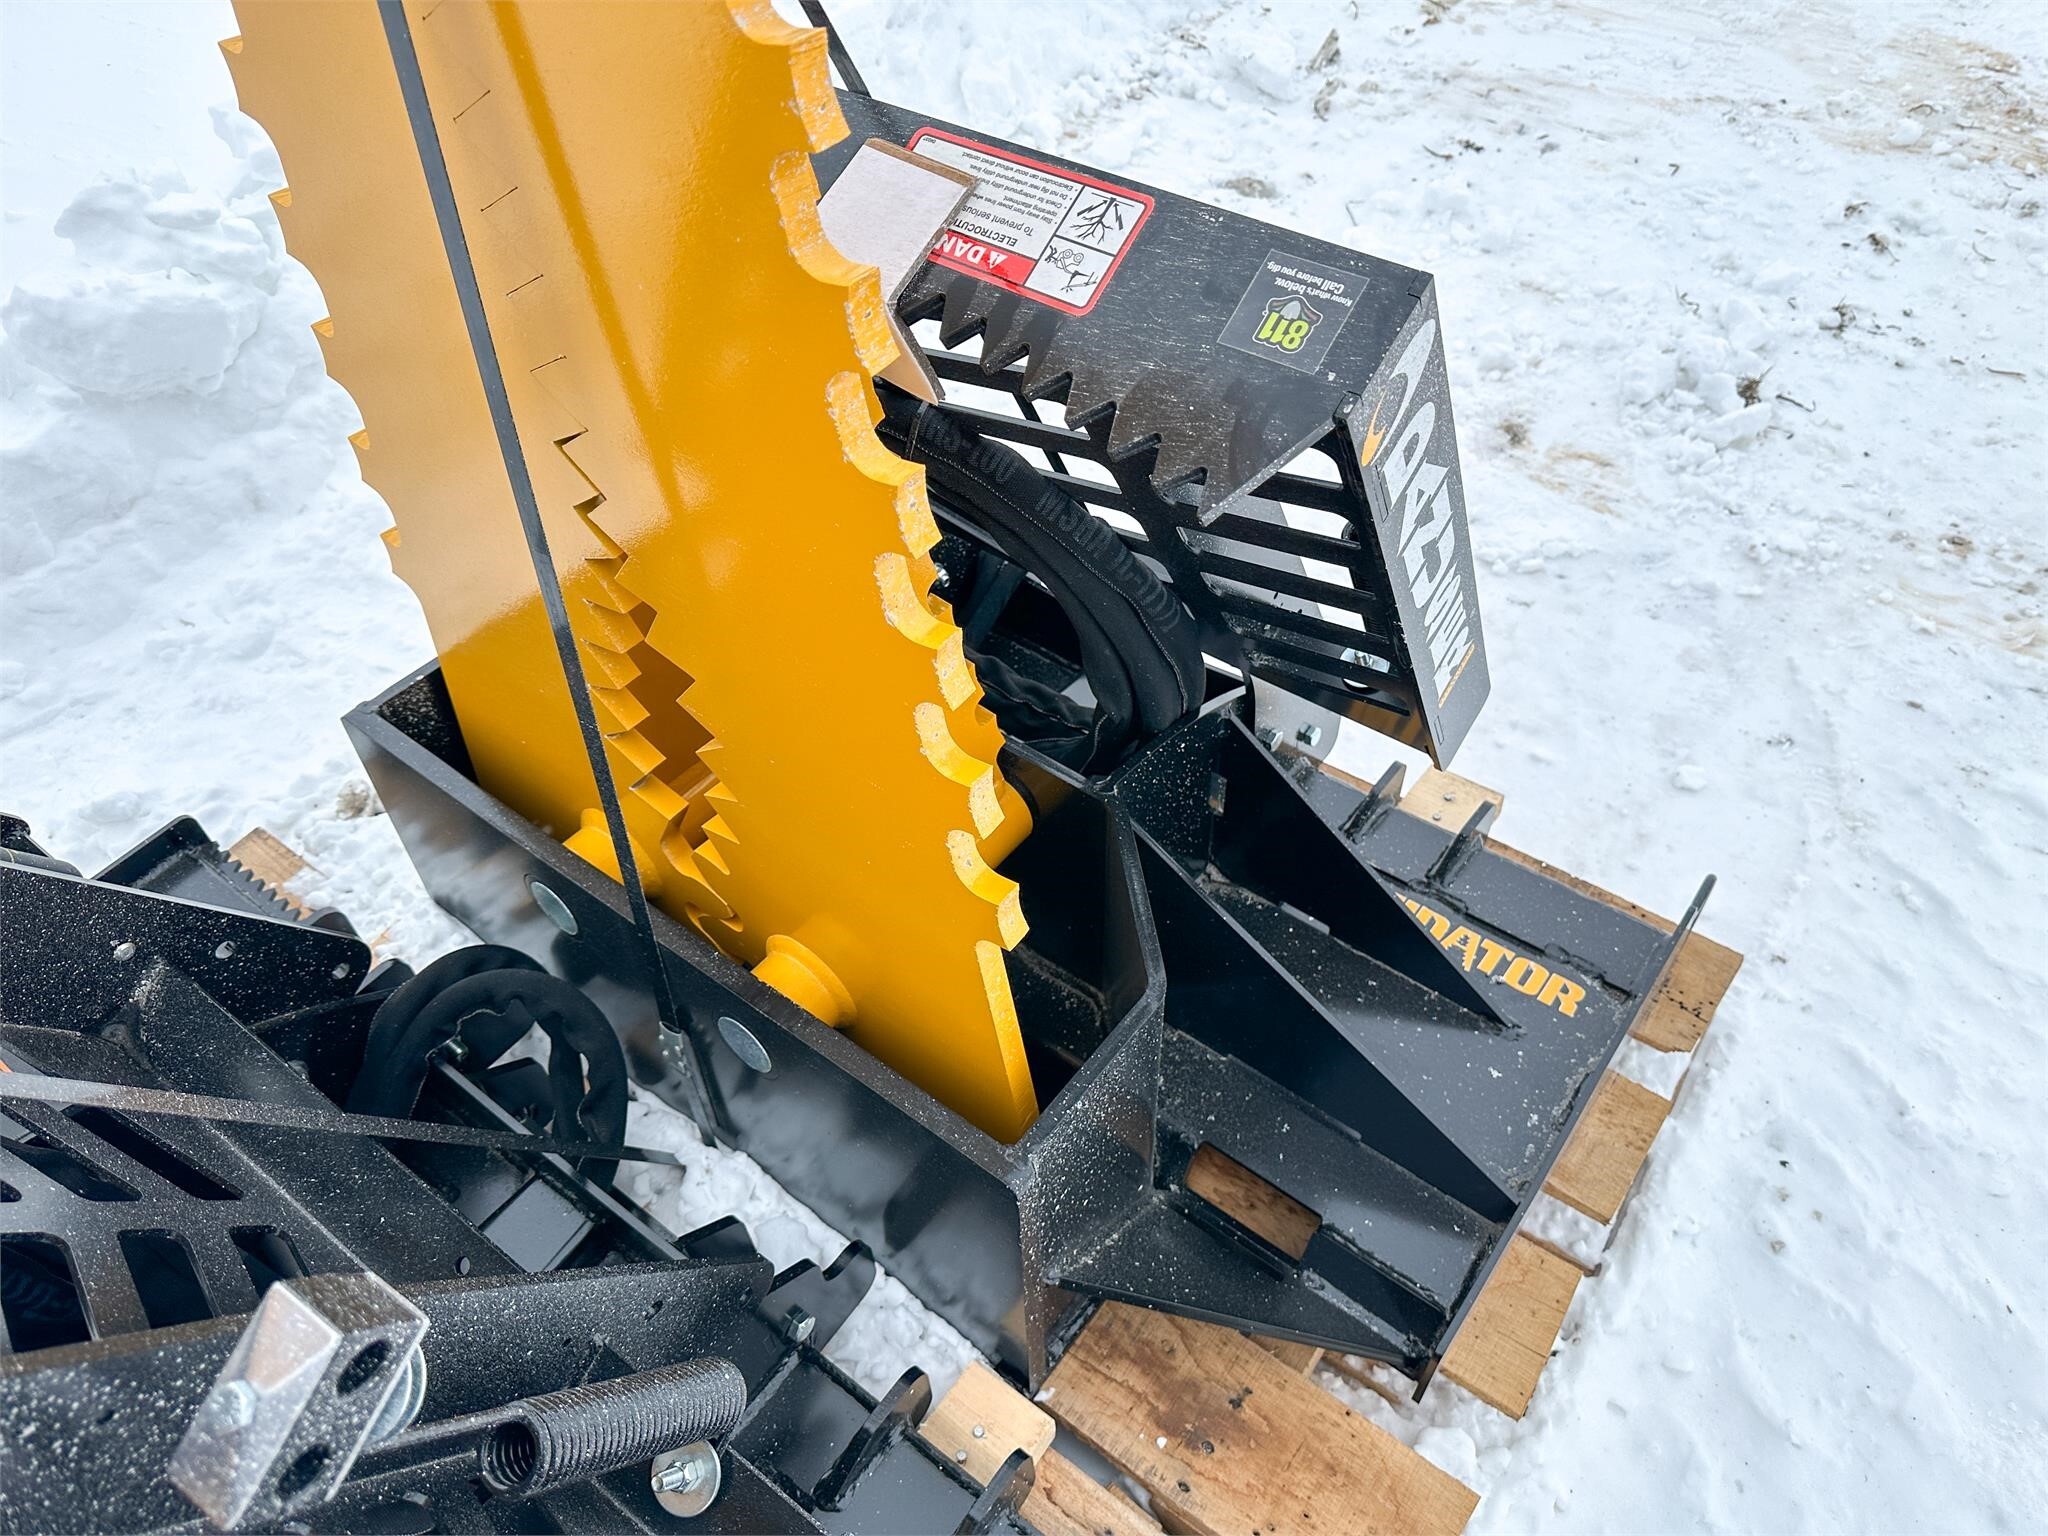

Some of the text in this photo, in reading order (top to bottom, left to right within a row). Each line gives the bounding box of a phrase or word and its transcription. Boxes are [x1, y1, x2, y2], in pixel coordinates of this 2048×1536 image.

[952, 217, 1018, 246] ELECTROCUTI
[961, 204, 1036, 237] To prevent serious
[933, 233, 986, 264] DAN
[1266, 260, 1344, 294] Call before you dig.
[1273, 276, 1352, 306] Know what's below.
[1257, 310, 1310, 351] 811
[1394, 892, 1585, 1017] DATOR
